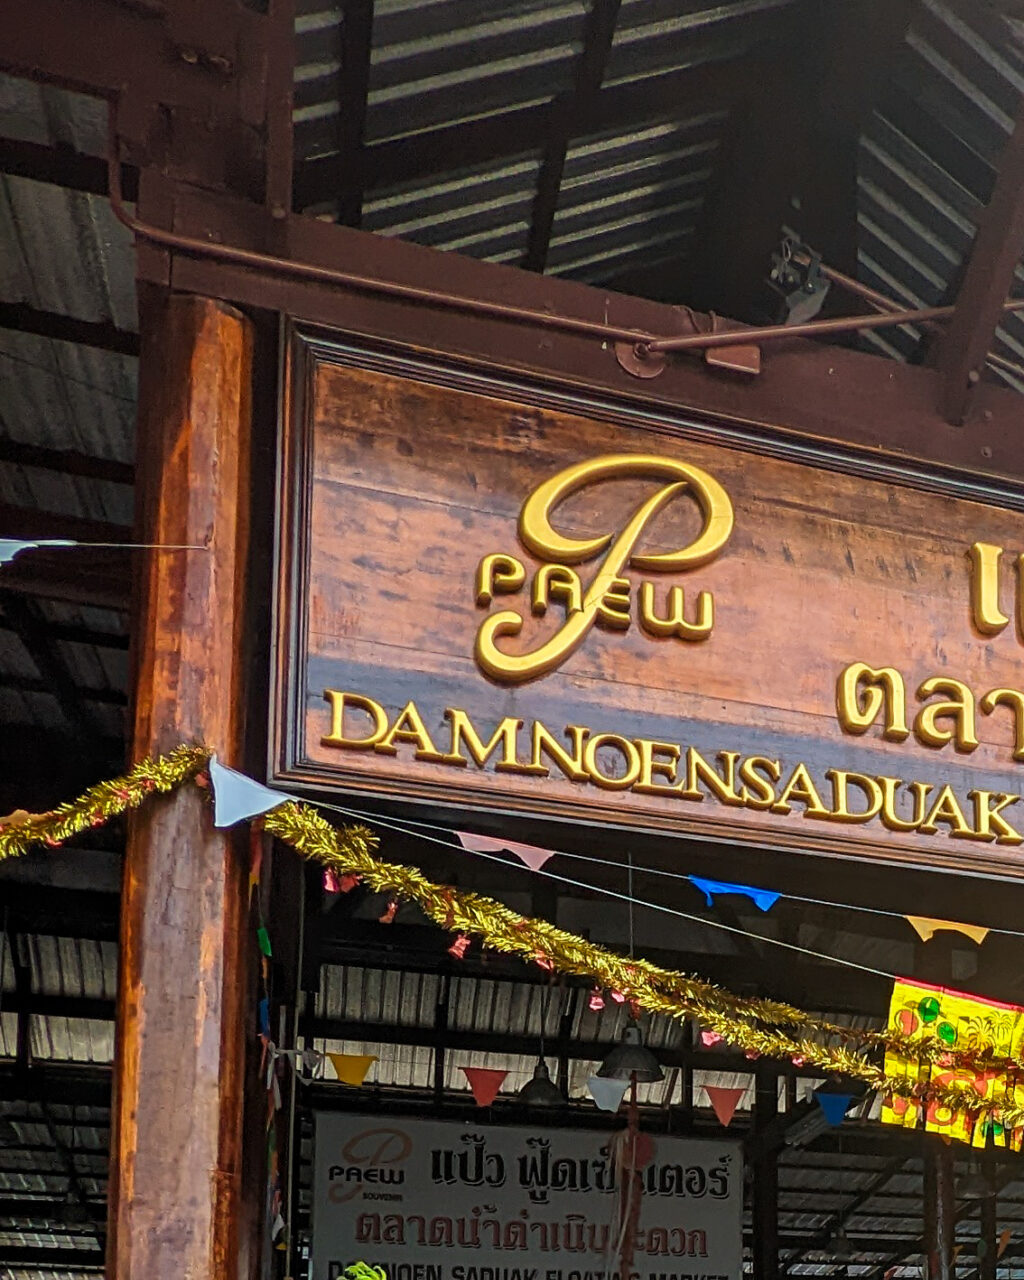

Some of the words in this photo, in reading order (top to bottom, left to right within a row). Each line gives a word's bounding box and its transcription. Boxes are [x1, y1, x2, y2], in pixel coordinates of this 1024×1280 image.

[475, 553, 714, 641] PAEW
[321, 688, 1024, 846] DAMNOENSADUAK
[328, 1165, 404, 1184] PAEW
[430, 1133, 506, 1187] แป๊ว
